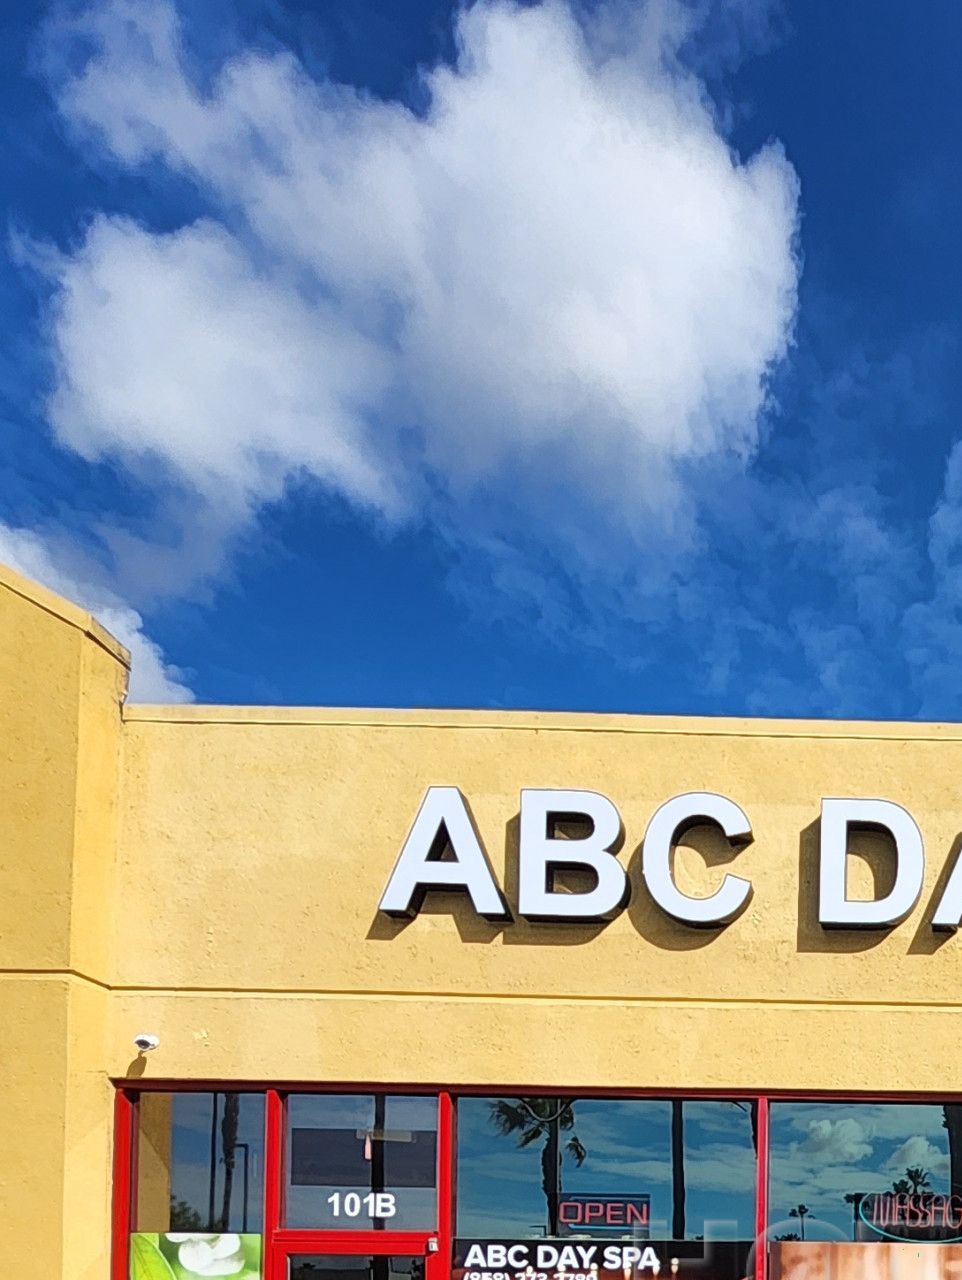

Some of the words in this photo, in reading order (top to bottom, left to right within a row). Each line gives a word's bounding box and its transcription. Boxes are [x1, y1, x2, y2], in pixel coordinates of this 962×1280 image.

[379, 785, 754, 925] ABC
[327, 1192, 396, 1218] 101B
[560, 1202, 648, 1224] OPEN
[464, 1244, 529, 1269] ABC
[536, 1245, 597, 1269] DAY
[603, 1246, 659, 1270] SPA
